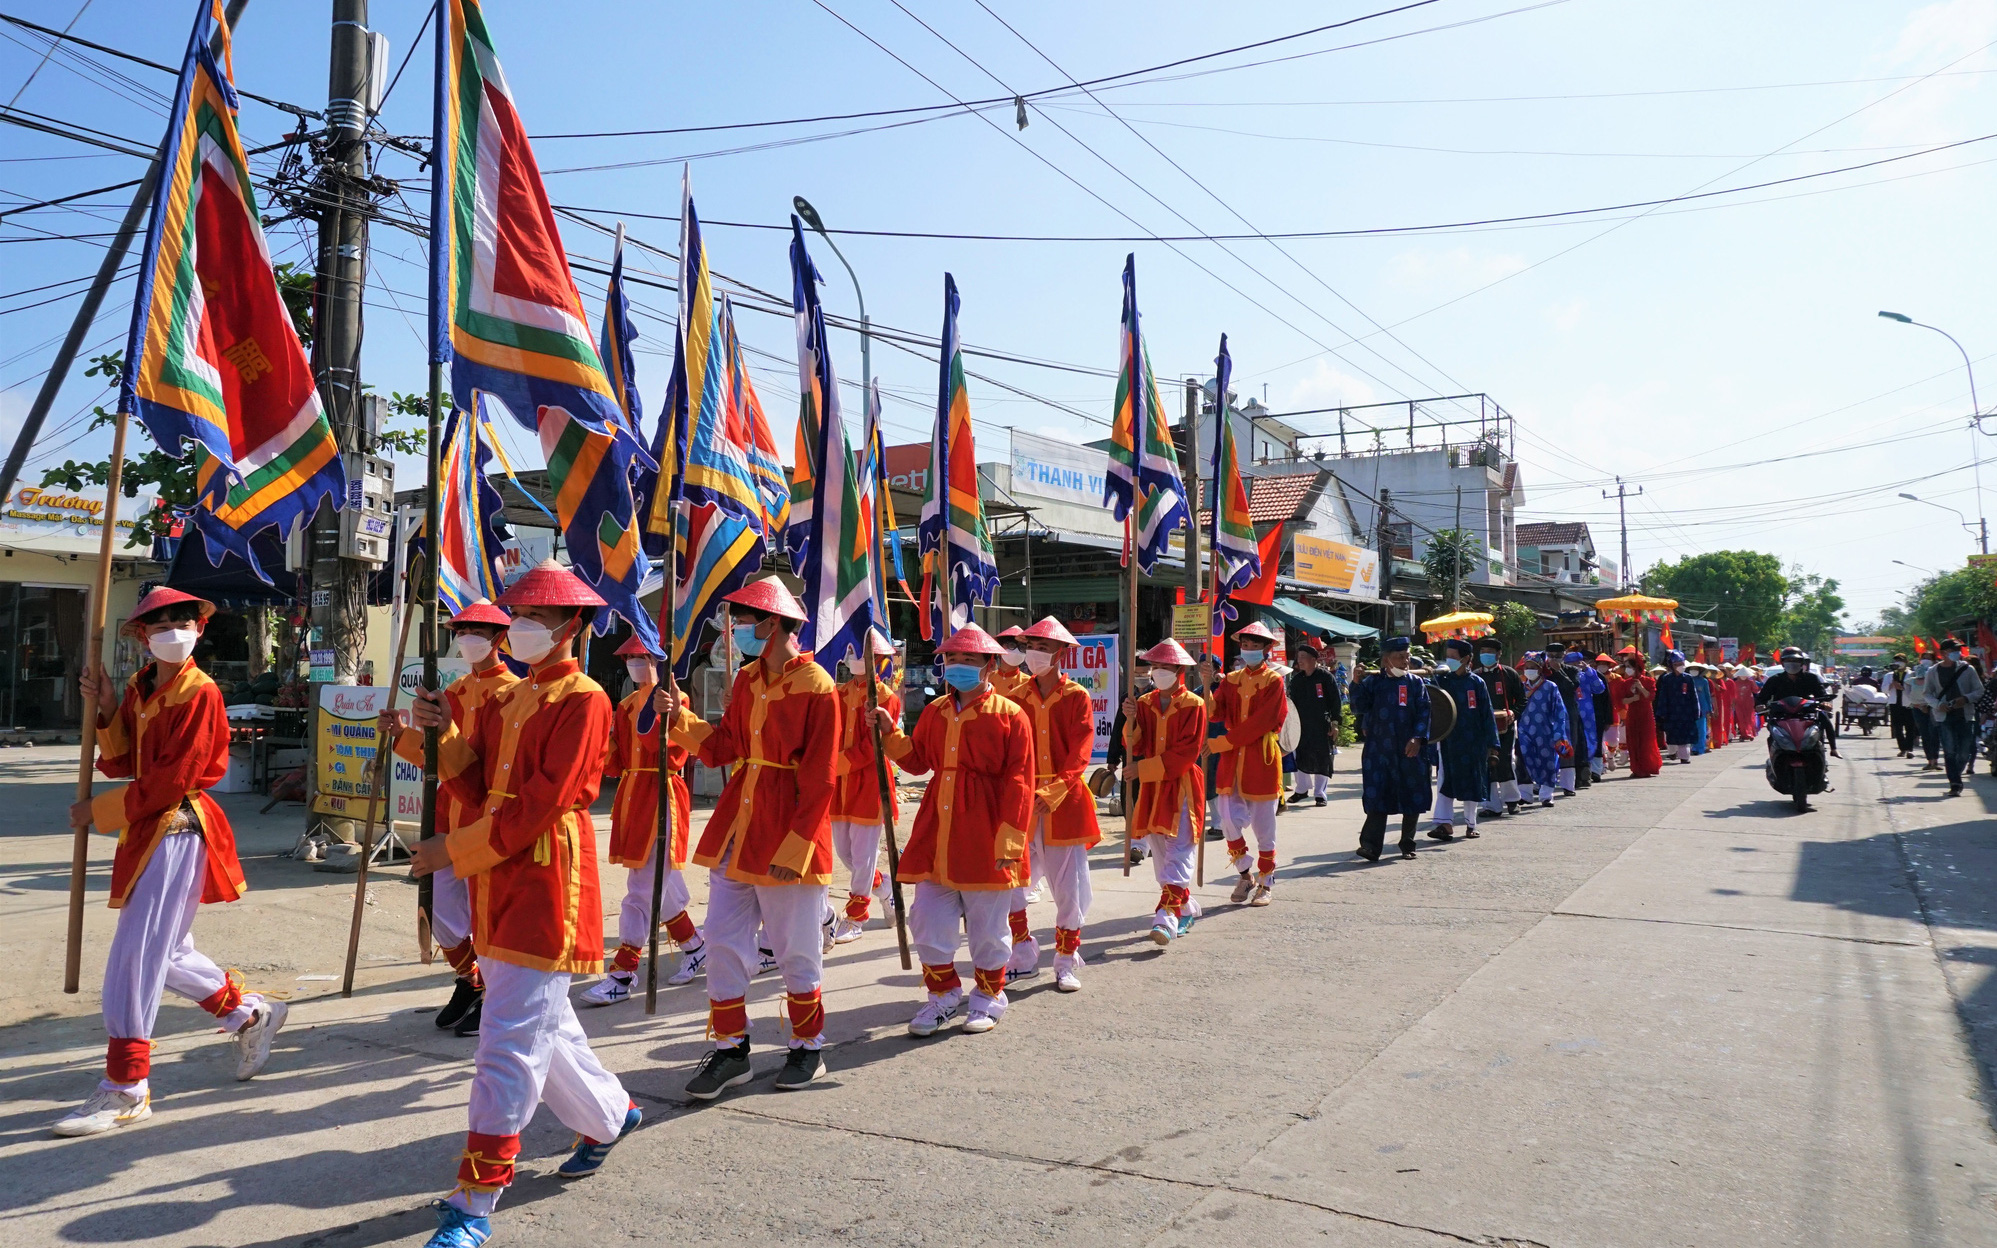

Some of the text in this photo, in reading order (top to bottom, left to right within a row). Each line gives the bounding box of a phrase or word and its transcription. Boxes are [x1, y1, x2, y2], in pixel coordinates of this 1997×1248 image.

[1027, 461, 1083, 491] THANH
[20, 488, 104, 515] Trương
[9, 510, 45, 522] Massage
[1083, 641, 1107, 669] GÀ
[332, 693, 355, 715] Quán
[343, 723, 376, 739] QUẢNG
[1096, 716, 1111, 736] dân
[355, 746, 377, 760] THỊT
